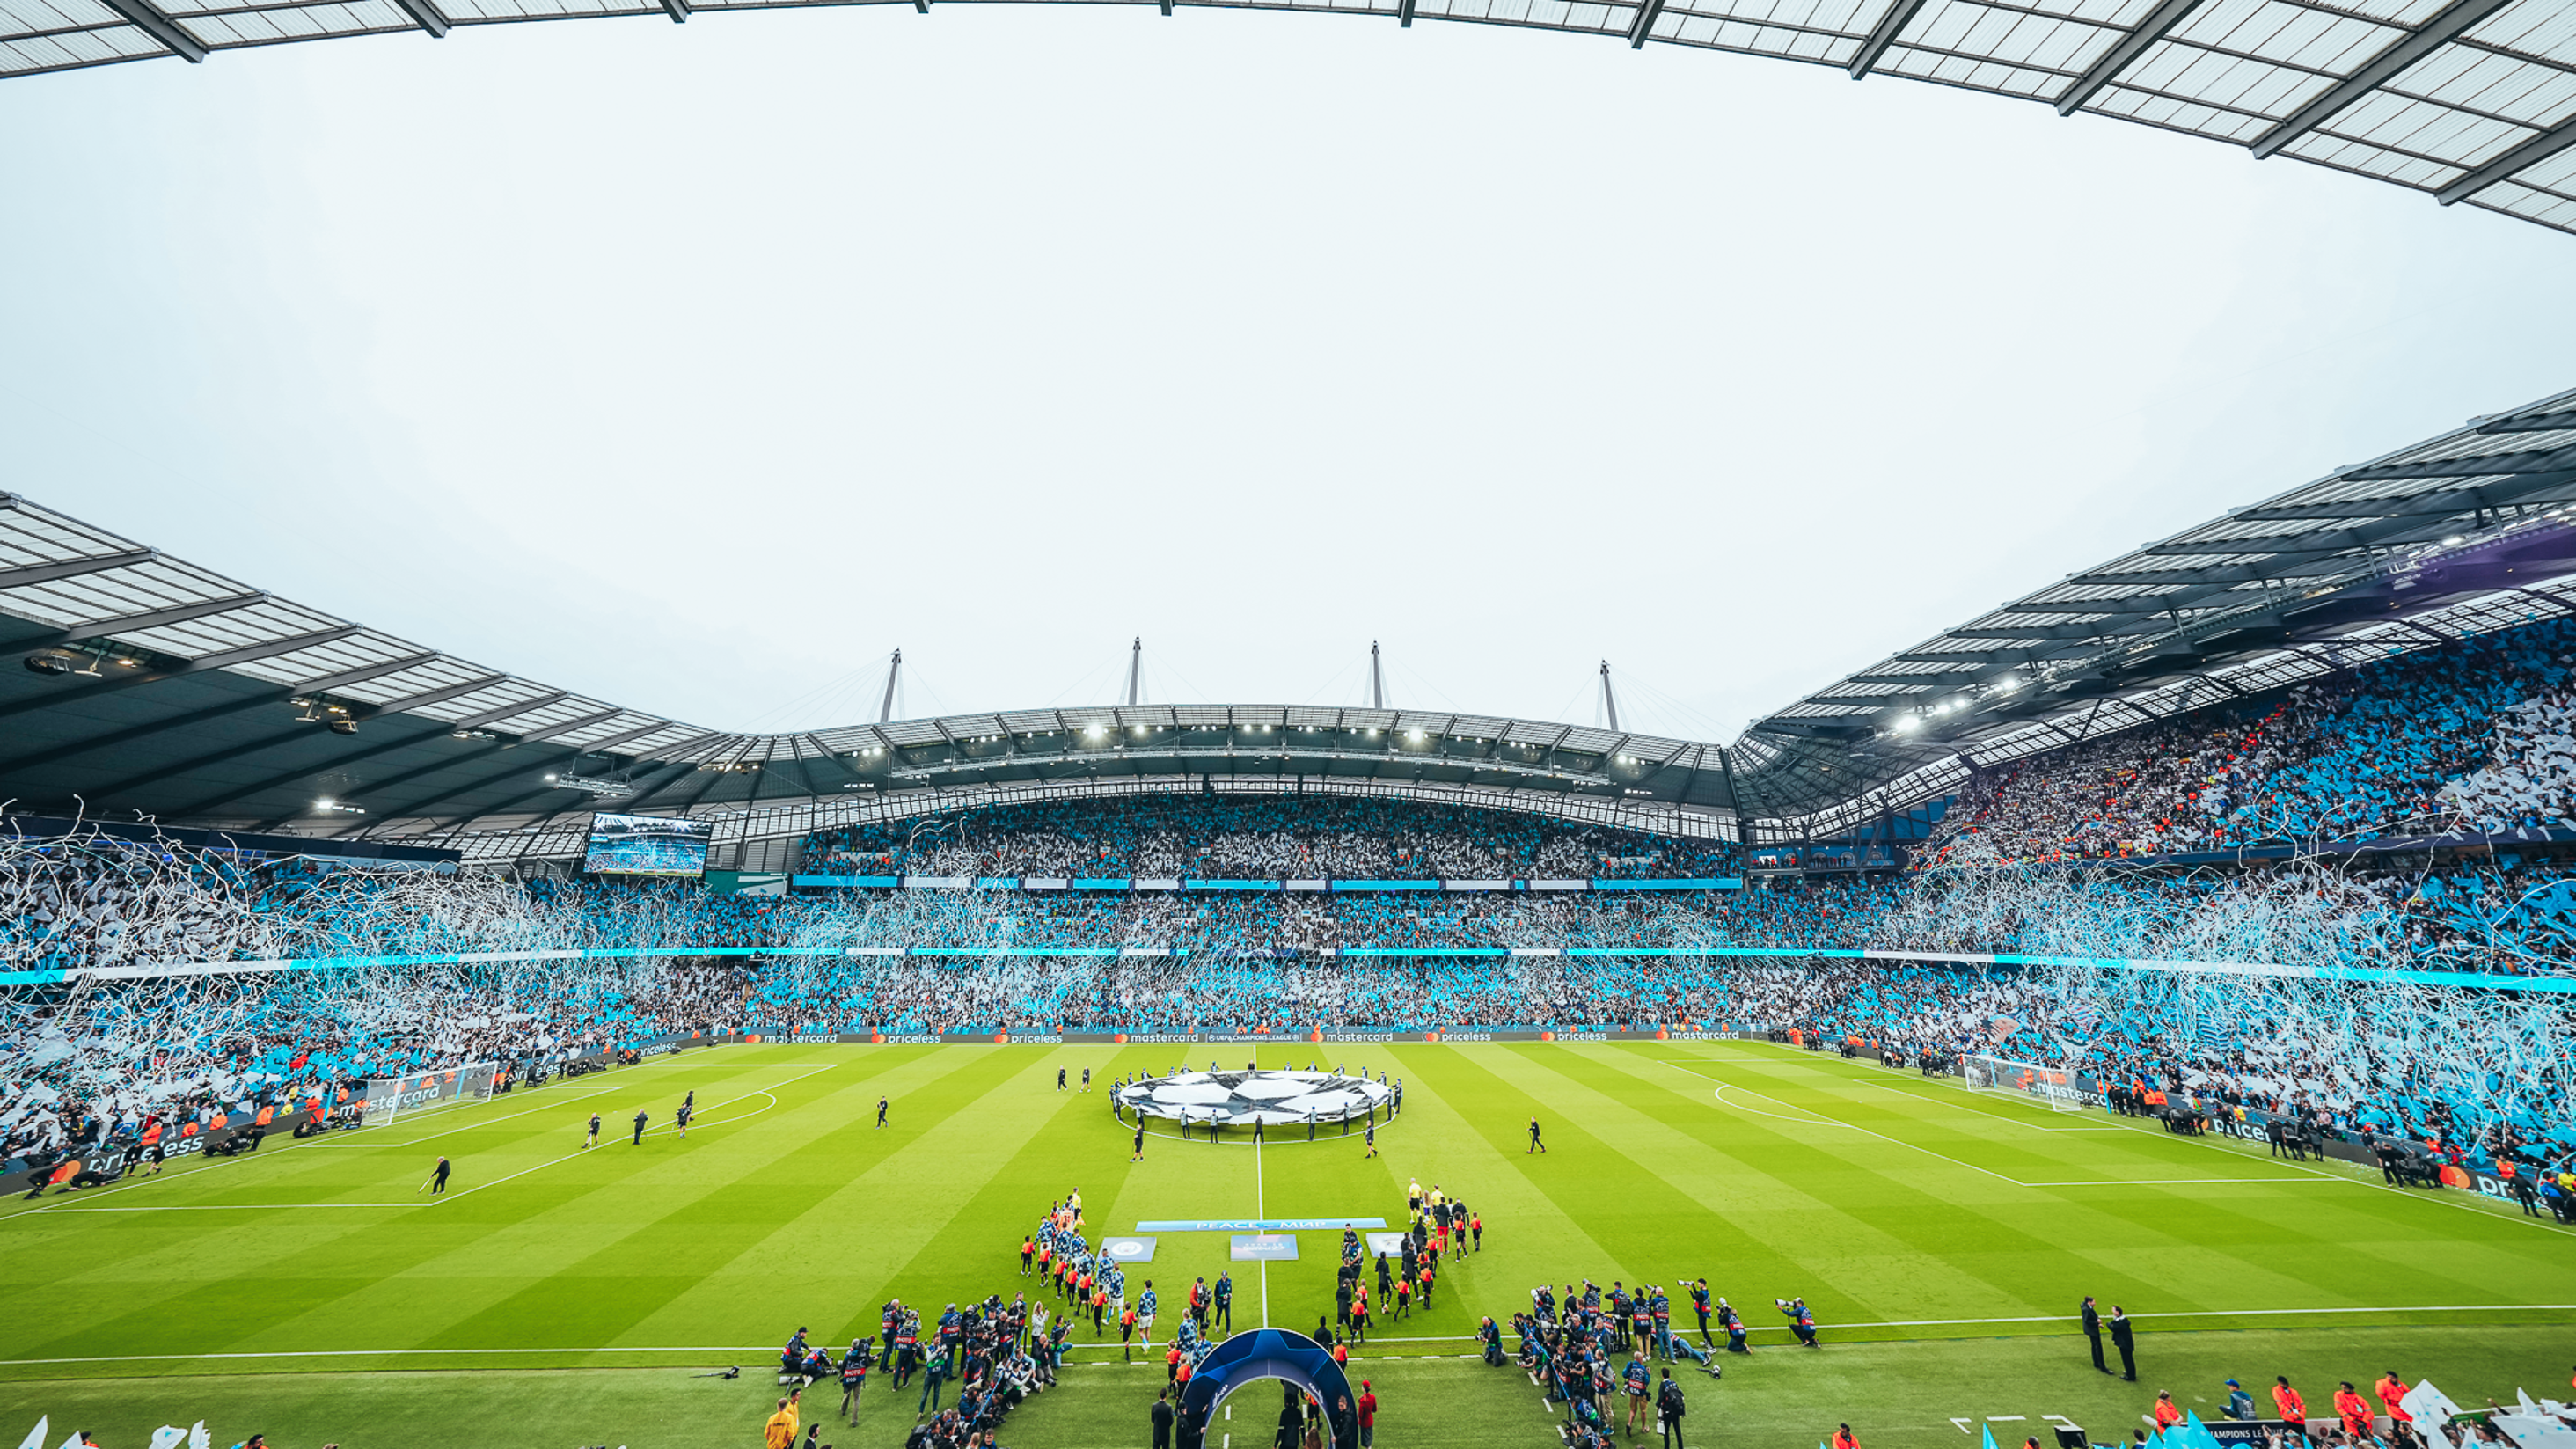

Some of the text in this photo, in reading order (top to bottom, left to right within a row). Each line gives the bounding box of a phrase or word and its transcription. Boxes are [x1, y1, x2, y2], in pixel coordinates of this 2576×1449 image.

[764, 1034, 838, 1043] matercard
[888, 1034, 941, 1044] priceless
[1011, 1034, 1063, 1044] priceless
[1131, 1034, 1198, 1043] mastercard
[1327, 1033, 1393, 1042] mastercard
[1442, 1033, 1491, 1043] priceless
[1558, 1032, 1607, 1043] priceless
[1672, 1031, 1739, 1040] mastercard
[2037, 1083, 2113, 1107] masterca
[339, 1085, 441, 1117] mstercard
